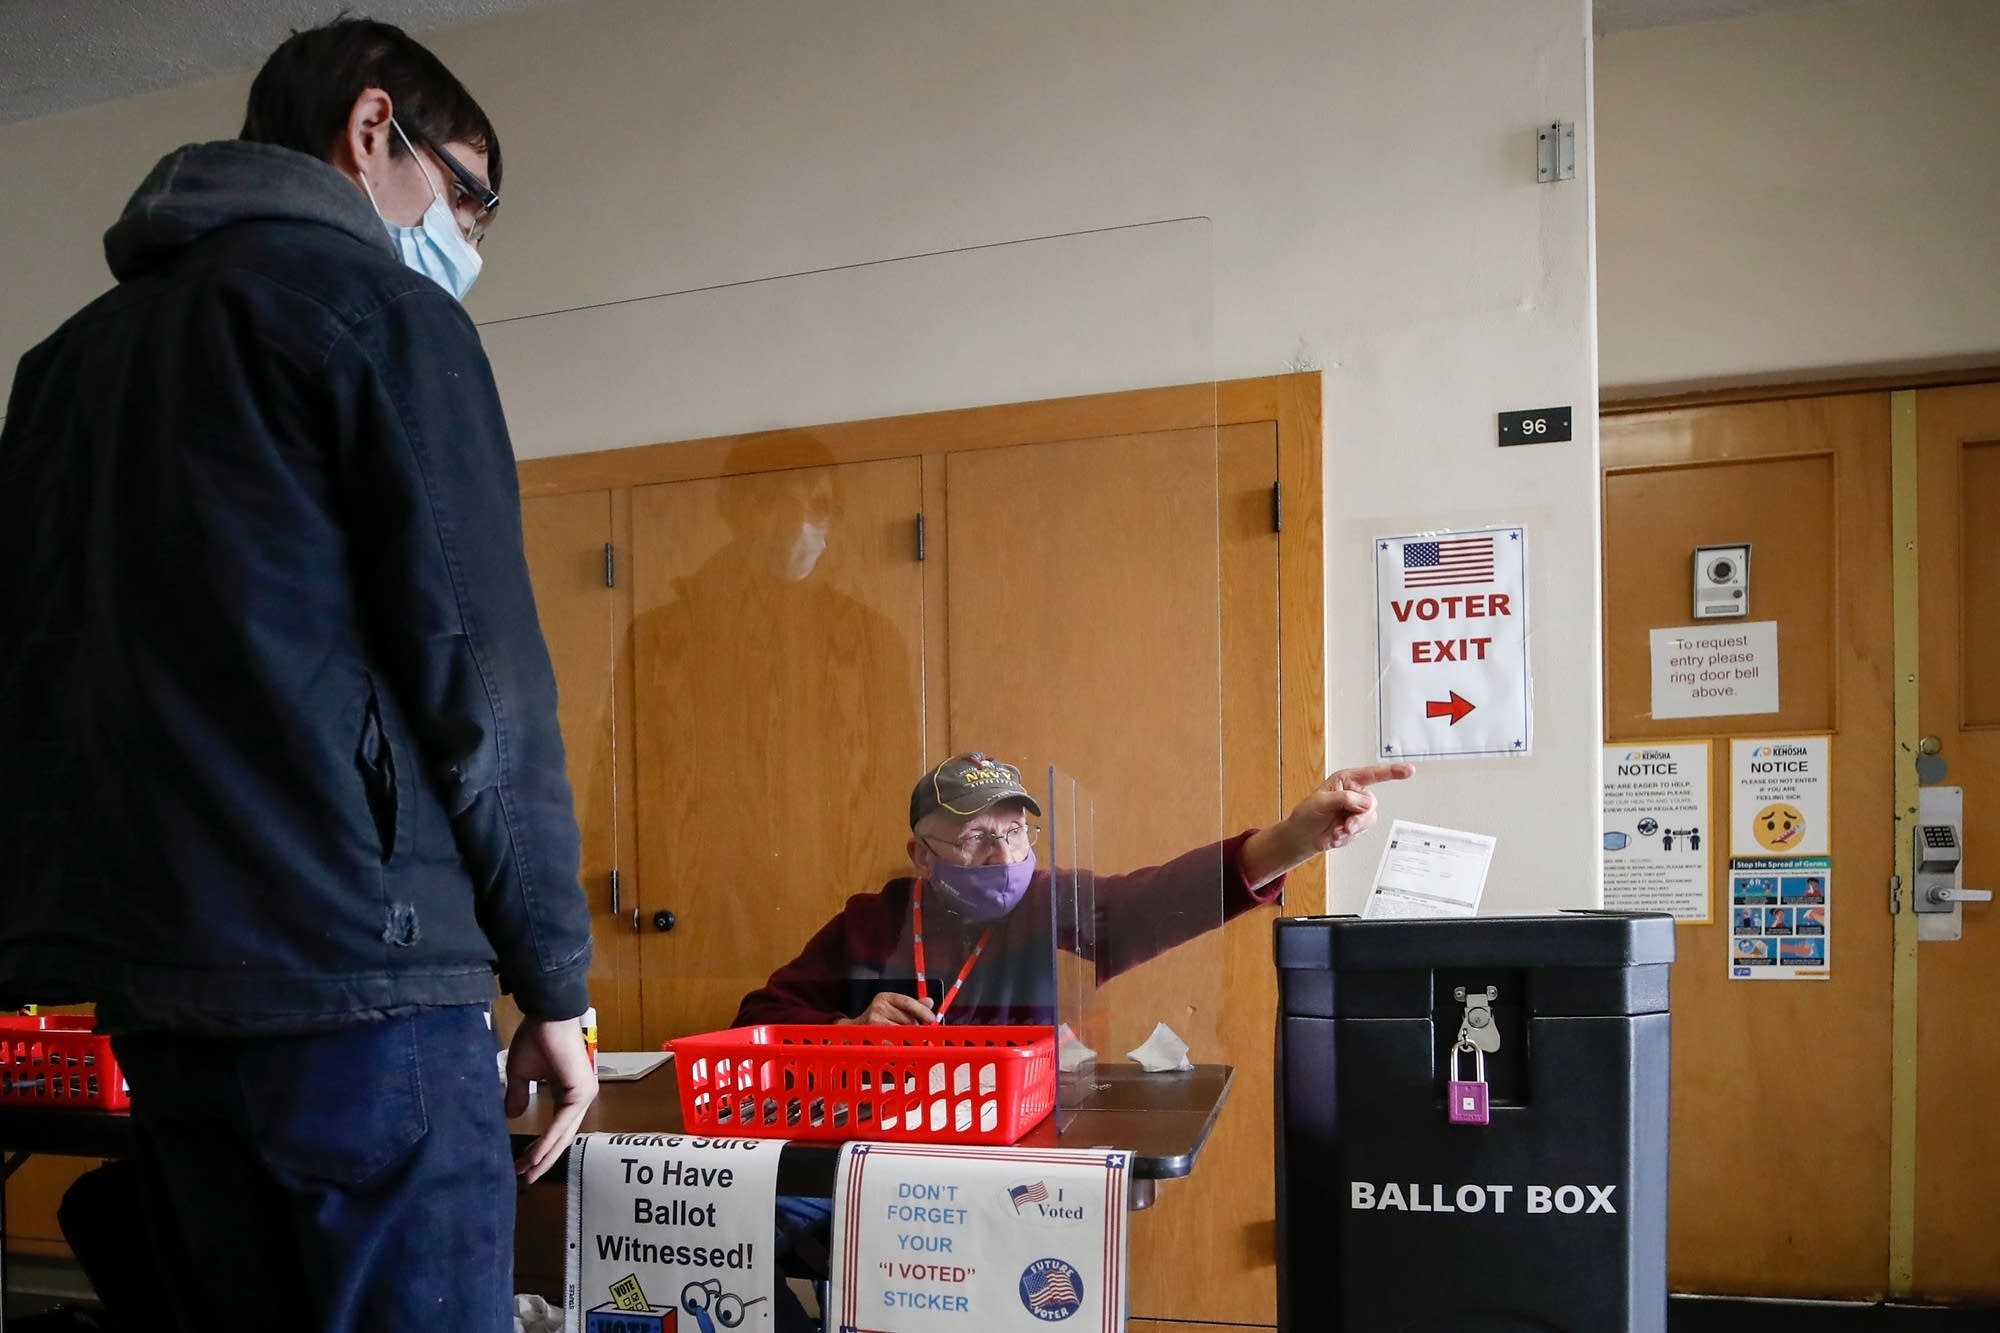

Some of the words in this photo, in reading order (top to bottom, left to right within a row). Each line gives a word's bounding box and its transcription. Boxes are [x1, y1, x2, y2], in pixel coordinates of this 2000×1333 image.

[1522, 418, 1547, 435] 96
[1390, 593, 1511, 622] VOTER
[1412, 637, 1492, 664] EXIT
[1676, 639, 1693, 650] To
[1696, 635, 1748, 651] request
[1670, 656, 1704, 668] entry
[1708, 652, 1754, 666] please
[1670, 672, 1696, 685] ring
[1700, 669, 1731, 681] door
[1735, 667, 1759, 680] bell
[1692, 686, 1737, 698] above.
[1642, 752, 1671, 760] KENOSHA
[1773, 747, 1807, 756] KENOSHA
[1618, 763, 1678, 776] NOTICE
[1751, 761, 1808, 773] NOTICE
[965, 769, 1014, 783] NAVY
[1737, 861, 1754, 869] Stop
[1768, 861, 1793, 869] Spread
[608, 1134, 684, 1147] Make
[620, 1158, 654, 1184] To
[662, 1160, 733, 1188] Have
[898, 1183, 958, 1201] DON'T
[1058, 1188, 1064, 1201] I
[1351, 1181, 1513, 1214] BALLOT
[1526, 1184, 1617, 1214] BOX
[634, 1198, 716, 1227] Ballot
[887, 1205, 968, 1225] FORGET
[1037, 1203, 1083, 1220] Voted
[596, 1234, 753, 1269] Witnessed!
[897, 1234, 953, 1253] YOUR
[1030, 1259, 1074, 1278] FUTURE
[614, 1279, 636, 1297] VOTE
[883, 1291, 969, 1312] STICKER
[1032, 1305, 1069, 1320] VOTER
